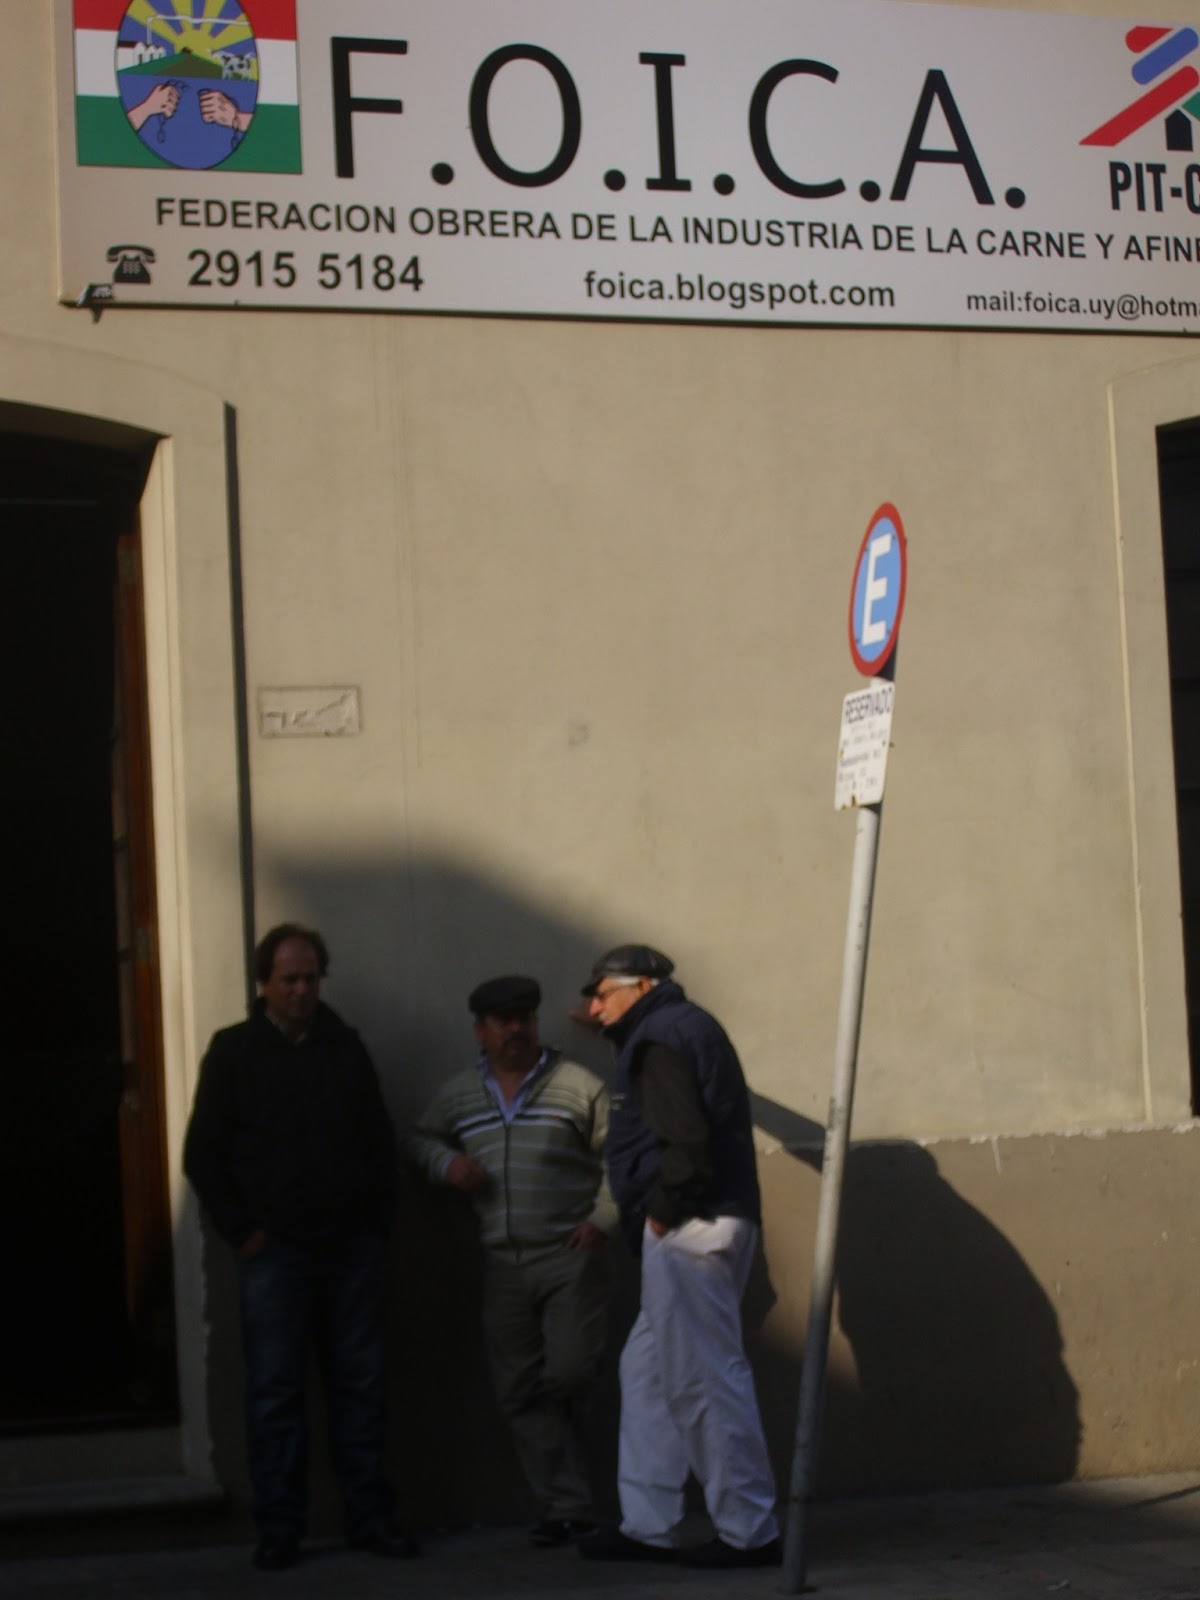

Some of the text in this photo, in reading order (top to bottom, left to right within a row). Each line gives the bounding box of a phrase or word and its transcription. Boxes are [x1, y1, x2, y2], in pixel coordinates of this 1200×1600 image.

[329, 36, 1027, 210] F.O.I.C.A.
[155, 197, 397, 235] FEDERACION
[408, 206, 562, 240] OBRERA
[570, 212, 618, 242] DE
[628, 214, 674, 244] LA
[682, 216, 864, 251] INDUSTRIA
[871, 224, 916, 253] DE
[925, 226, 969, 255] LA
[975, 228, 1087, 259] CARNE
[1094, 233, 1115, 260] Y
[187, 248, 425, 293] 2915 5184
[583, 269, 896, 310] foica.blogspot.com
[966, 290, 1200, 321] mail:foica.uy@hotm
[861, 533, 892, 646] E
